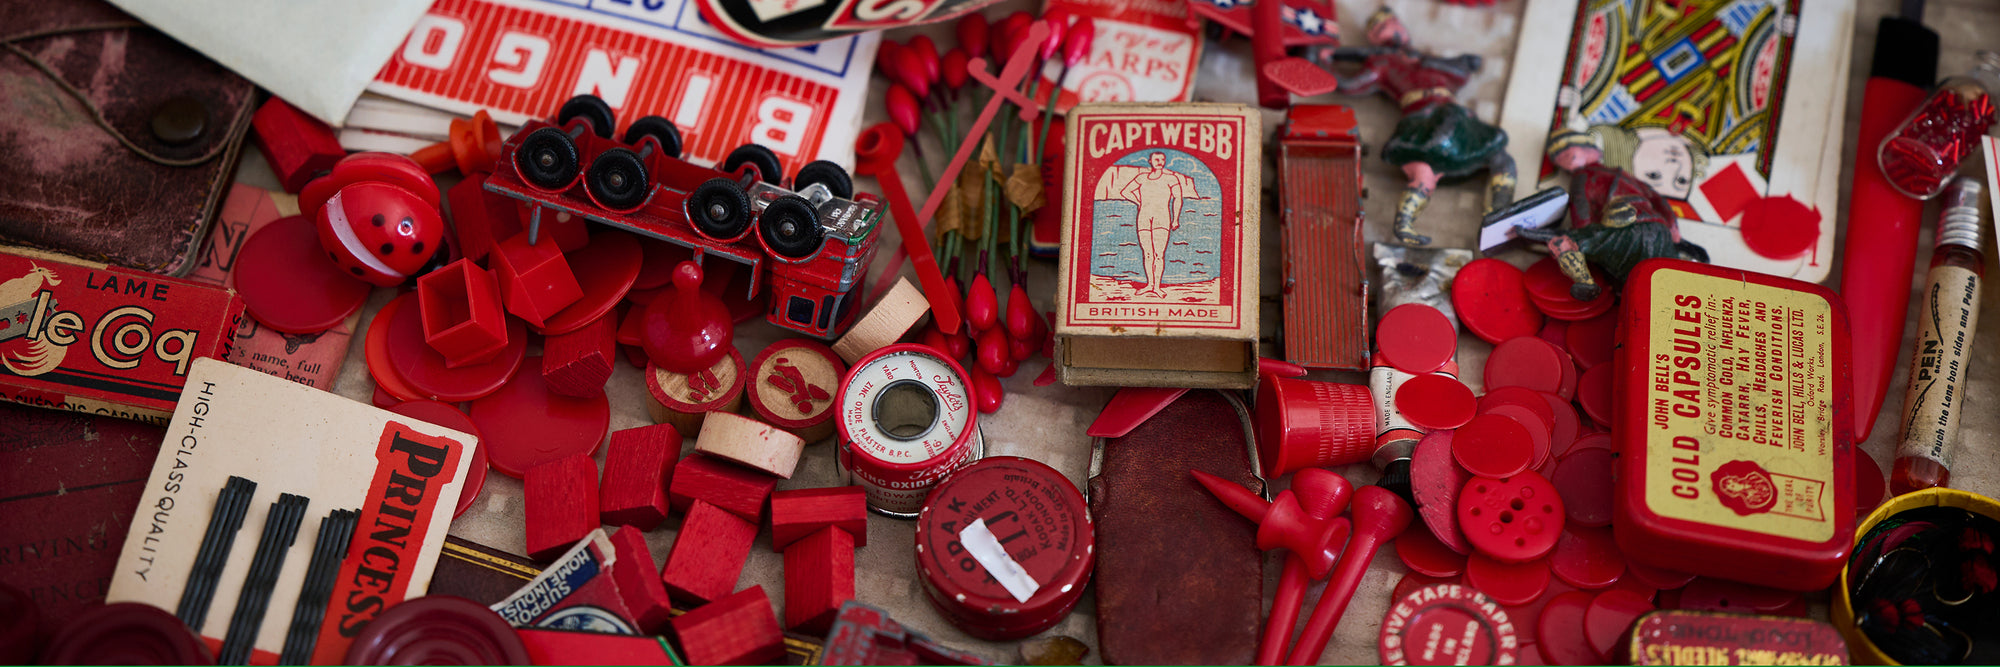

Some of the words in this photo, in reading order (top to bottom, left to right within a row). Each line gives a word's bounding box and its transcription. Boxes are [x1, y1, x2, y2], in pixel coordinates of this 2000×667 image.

[402, 14, 816, 157] BINGO
[1089, 123, 1158, 159] CAPT.
[1160, 123, 1233, 160] WEBB
[86, 272, 170, 301] LAME
[1089, 307, 1159, 317] BRITISH
[1168, 308, 1219, 318] MADE
[1704, 312, 1717, 341] relief
[1719, 296, 1736, 350] INFLUENZA,
[1736, 299, 1752, 339] FEVER,
[1754, 301, 1767, 322] AND
[1791, 309, 1804, 327] LTD.
[1959, 308, 1969, 329] and
[26, 289, 85, 346] le
[90, 304, 199, 377] Coq
[1769, 304, 1783, 382] CONDITIONS.
[1792, 328, 1804, 358] LUCAS
[252, 352, 290, 369] name,
[297, 360, 322, 374] full
[882, 364, 894, 380] YARD
[1655, 353, 1670, 392] BELL'S
[1672, 294, 1702, 419] CAPSULES
[1719, 355, 1735, 386] COLD,
[1736, 348, 1750, 372] HAY
[1753, 331, 1767, 392] HEADACHES
[1792, 359, 1804, 369] &
[1934, 348, 1943, 374] BRAND
[1947, 359, 1959, 383] both
[859, 381, 874, 398] ZINC
[1704, 344, 1720, 409] symptomatic
[1793, 372, 1805, 398] HILLS
[1807, 382, 1815, 407] Oxford
[1942, 384, 1953, 408] Lens
[854, 401, 863, 424] OXIDE
[1655, 398, 1669, 430] JOHN
[1704, 410, 1716, 435] Give
[1719, 391, 1733, 439] COMMON
[1736, 383, 1751, 441] CATARRH,
[1753, 403, 1768, 444] CHILLS,
[1769, 389, 1783, 447] FEVERISH
[1938, 409, 1949, 427] the
[164, 381, 216, 494] HIGH-CLASS
[859, 427, 886, 454] PLASTER
[1793, 428, 1805, 452] JOHN
[856, 466, 886, 486] ZINC
[891, 477, 934, 489] OXIDE
[1671, 435, 1700, 499] COLD
[1023, 489, 1057, 534] LONDON
[135, 496, 175, 583] QUALITY
[338, 431, 449, 638] PRINCESS
[1025, 511, 1053, 550] KODAK
[551, 548, 590, 587] HOME
[1384, 602, 1413, 665] ESIVE
[1408, 584, 1462, 605] TAPE
[1422, 622, 1444, 662] MADE
[1455, 620, 1480, 666] NGLAND
